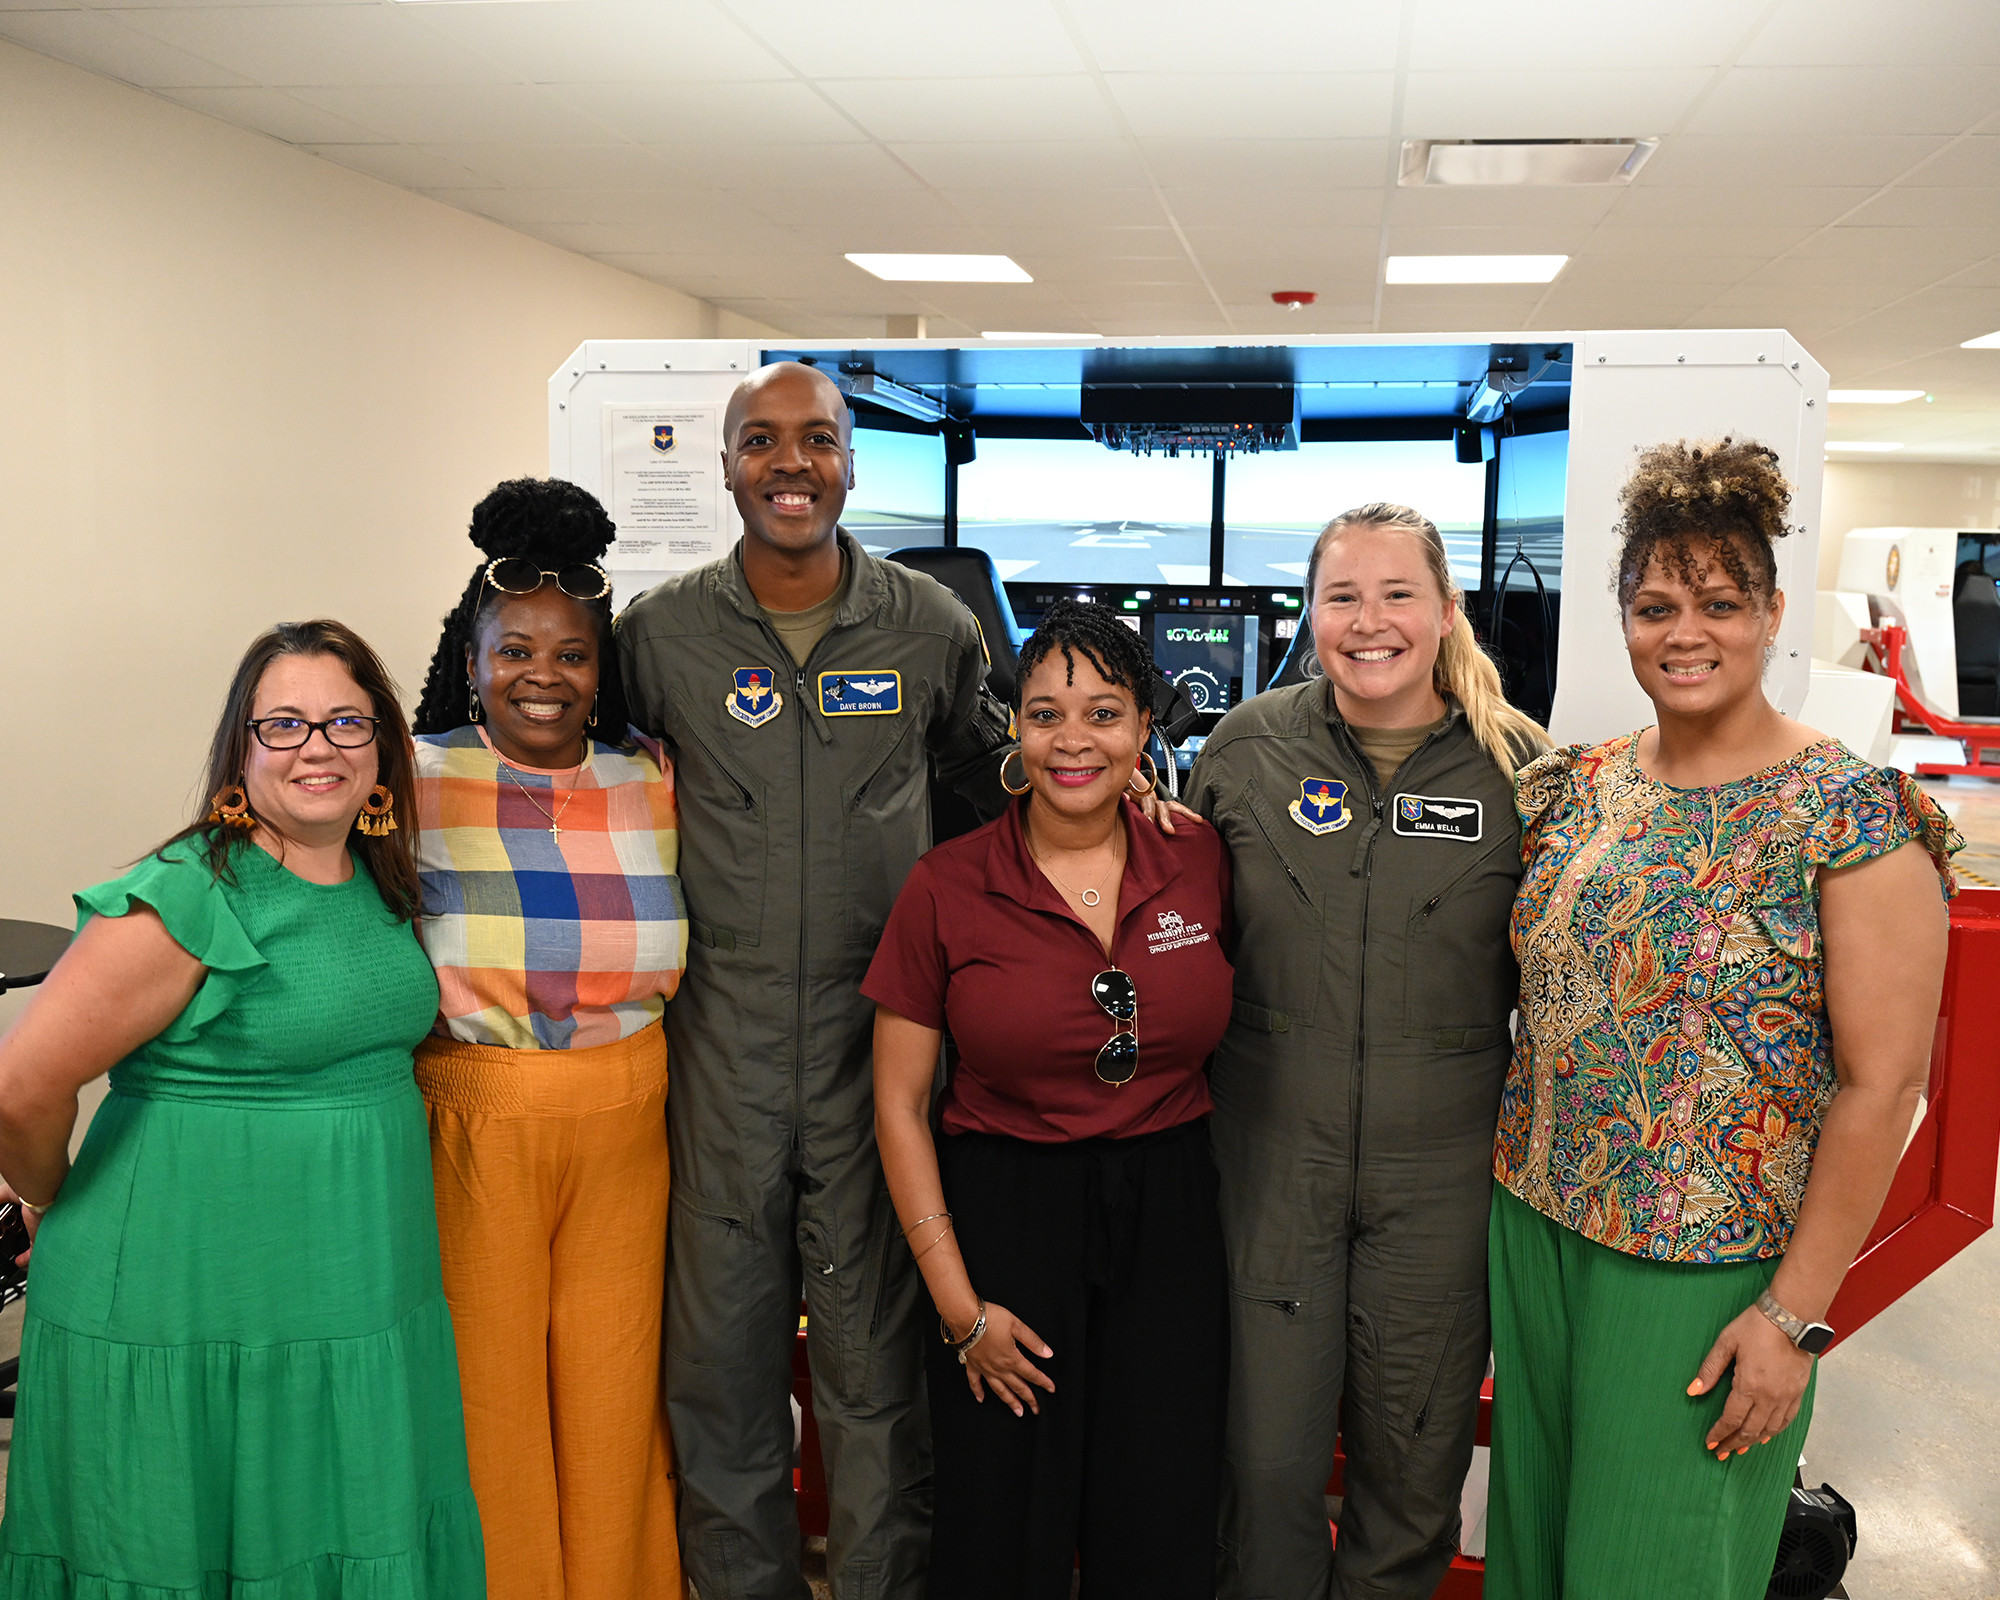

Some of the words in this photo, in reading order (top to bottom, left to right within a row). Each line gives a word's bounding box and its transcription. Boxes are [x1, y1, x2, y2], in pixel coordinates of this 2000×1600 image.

[840, 703, 857, 711] DAVE
[858, 702, 882, 710] BROWN
[1415, 822, 1435, 831] EMMA
[1436, 823, 1460, 833] WELLS
[1185, 923, 1203, 932] STATE
